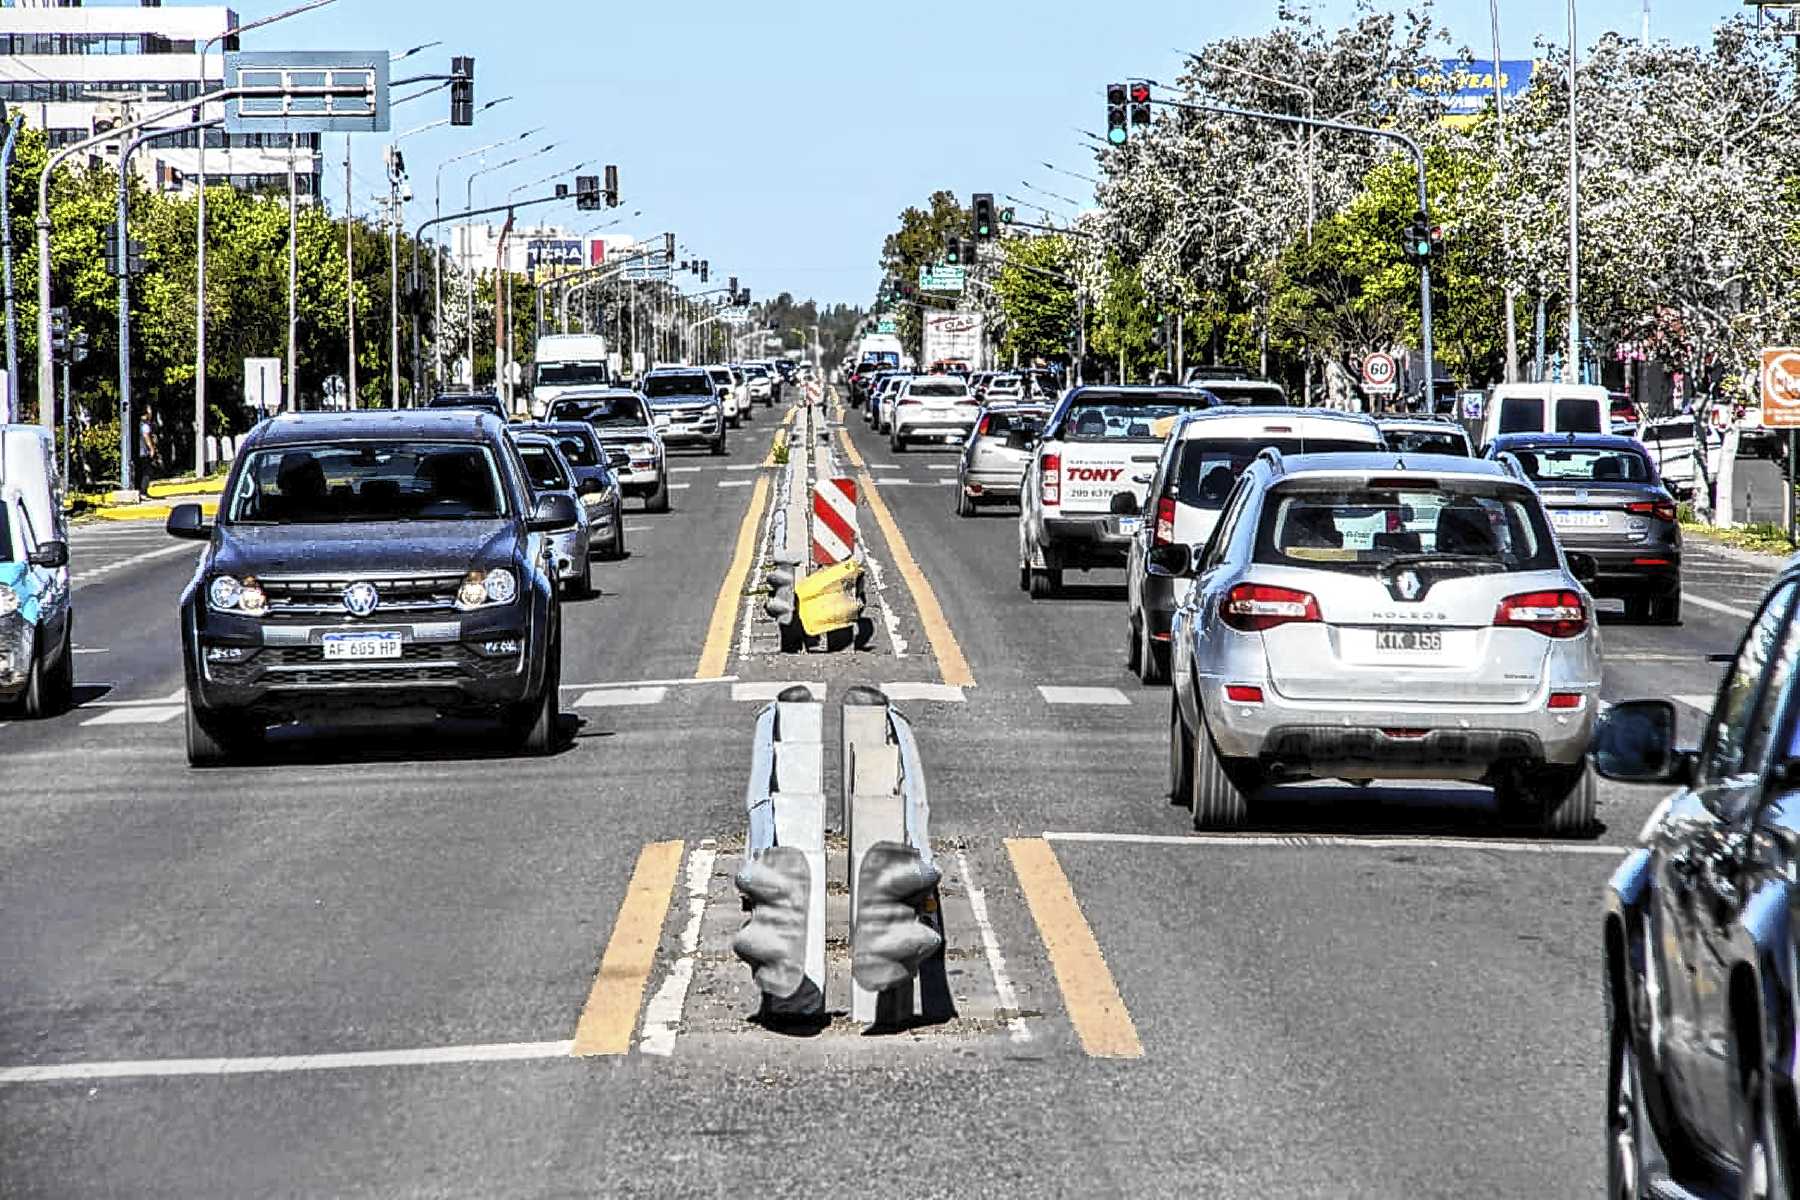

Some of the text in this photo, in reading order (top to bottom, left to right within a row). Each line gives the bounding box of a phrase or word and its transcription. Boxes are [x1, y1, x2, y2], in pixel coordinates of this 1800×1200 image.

[1371, 363, 1389, 376] 60
[1066, 467, 1125, 482] TONY
[1413, 631, 1441, 649] 156
[329, 642, 345, 655] AF
[380, 641, 396, 655] HP
